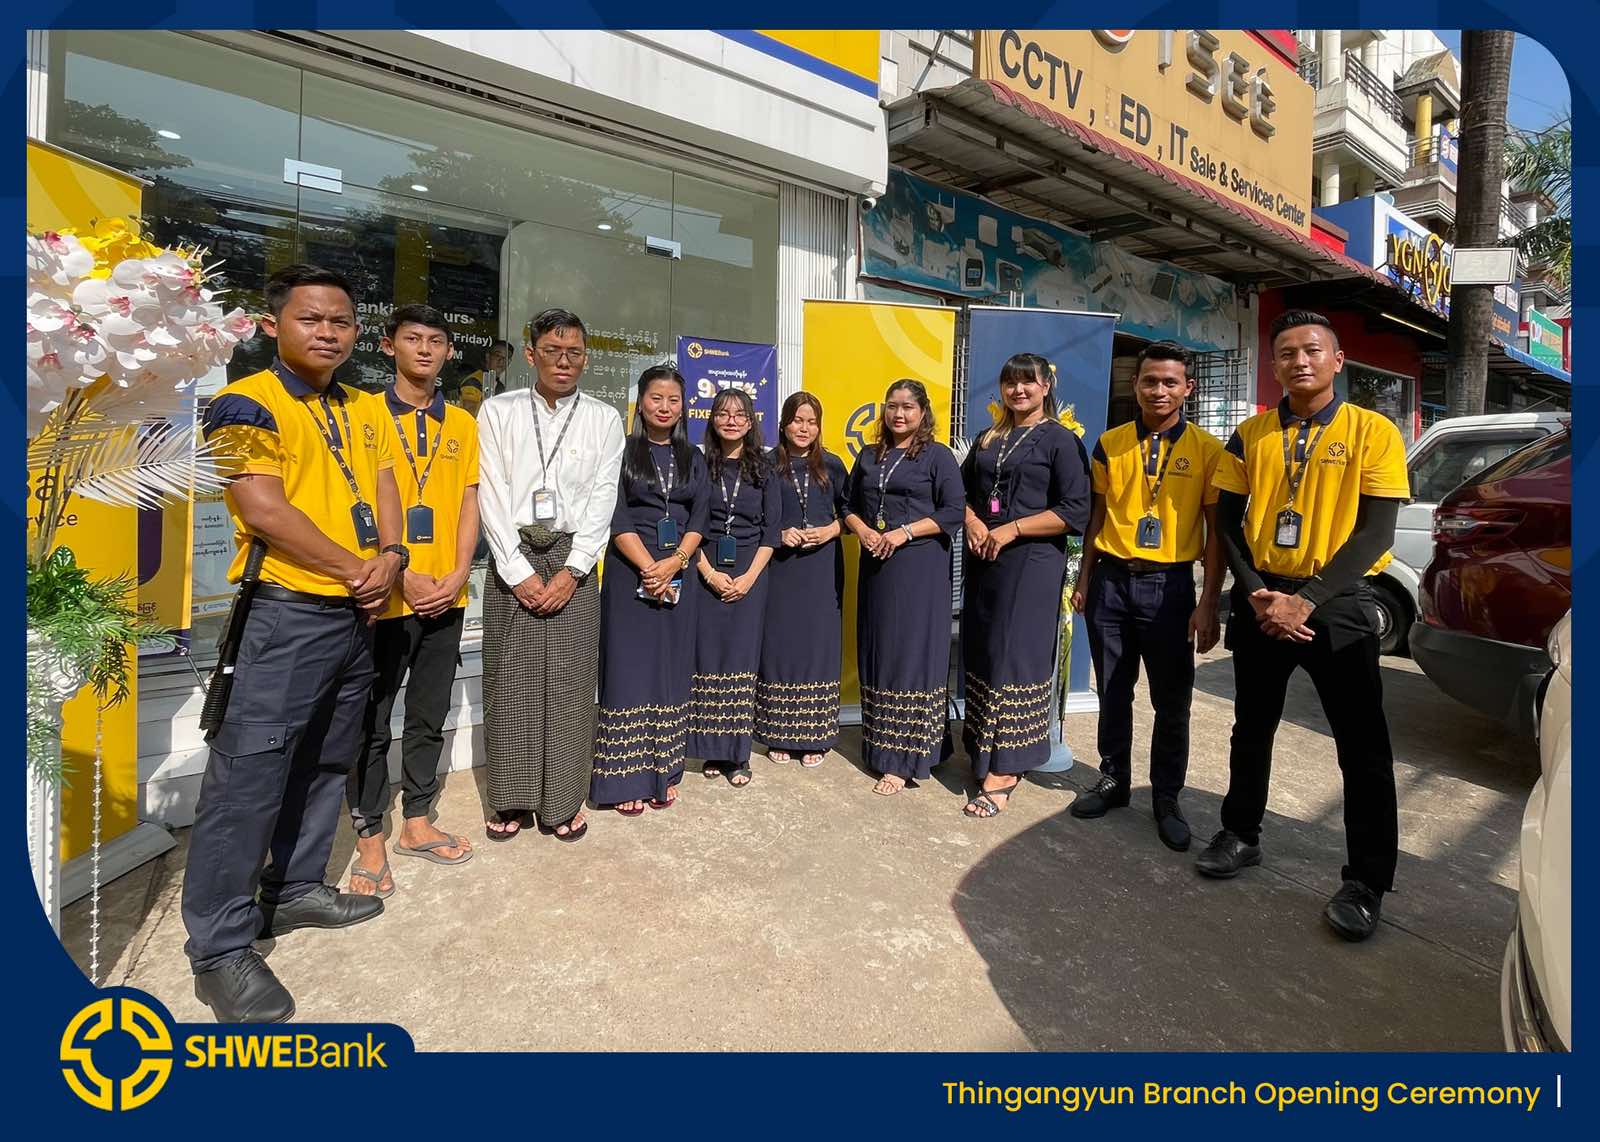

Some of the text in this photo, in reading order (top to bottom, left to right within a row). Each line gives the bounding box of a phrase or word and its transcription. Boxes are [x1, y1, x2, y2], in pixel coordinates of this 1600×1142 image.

[1000, 29, 1082, 109] CCTV
[1170, 122, 1189, 165] IT
[1190, 147, 1216, 181] Sale
[1219, 161, 1228, 187] &
[1231, 168, 1274, 211] Services
[1277, 193, 1305, 227] Center
[1392, 233, 1424, 275] YGN
[357, 301, 398, 315] anki
[453, 332, 493, 347] Friday)
[688, 409, 712, 419] FIXE
